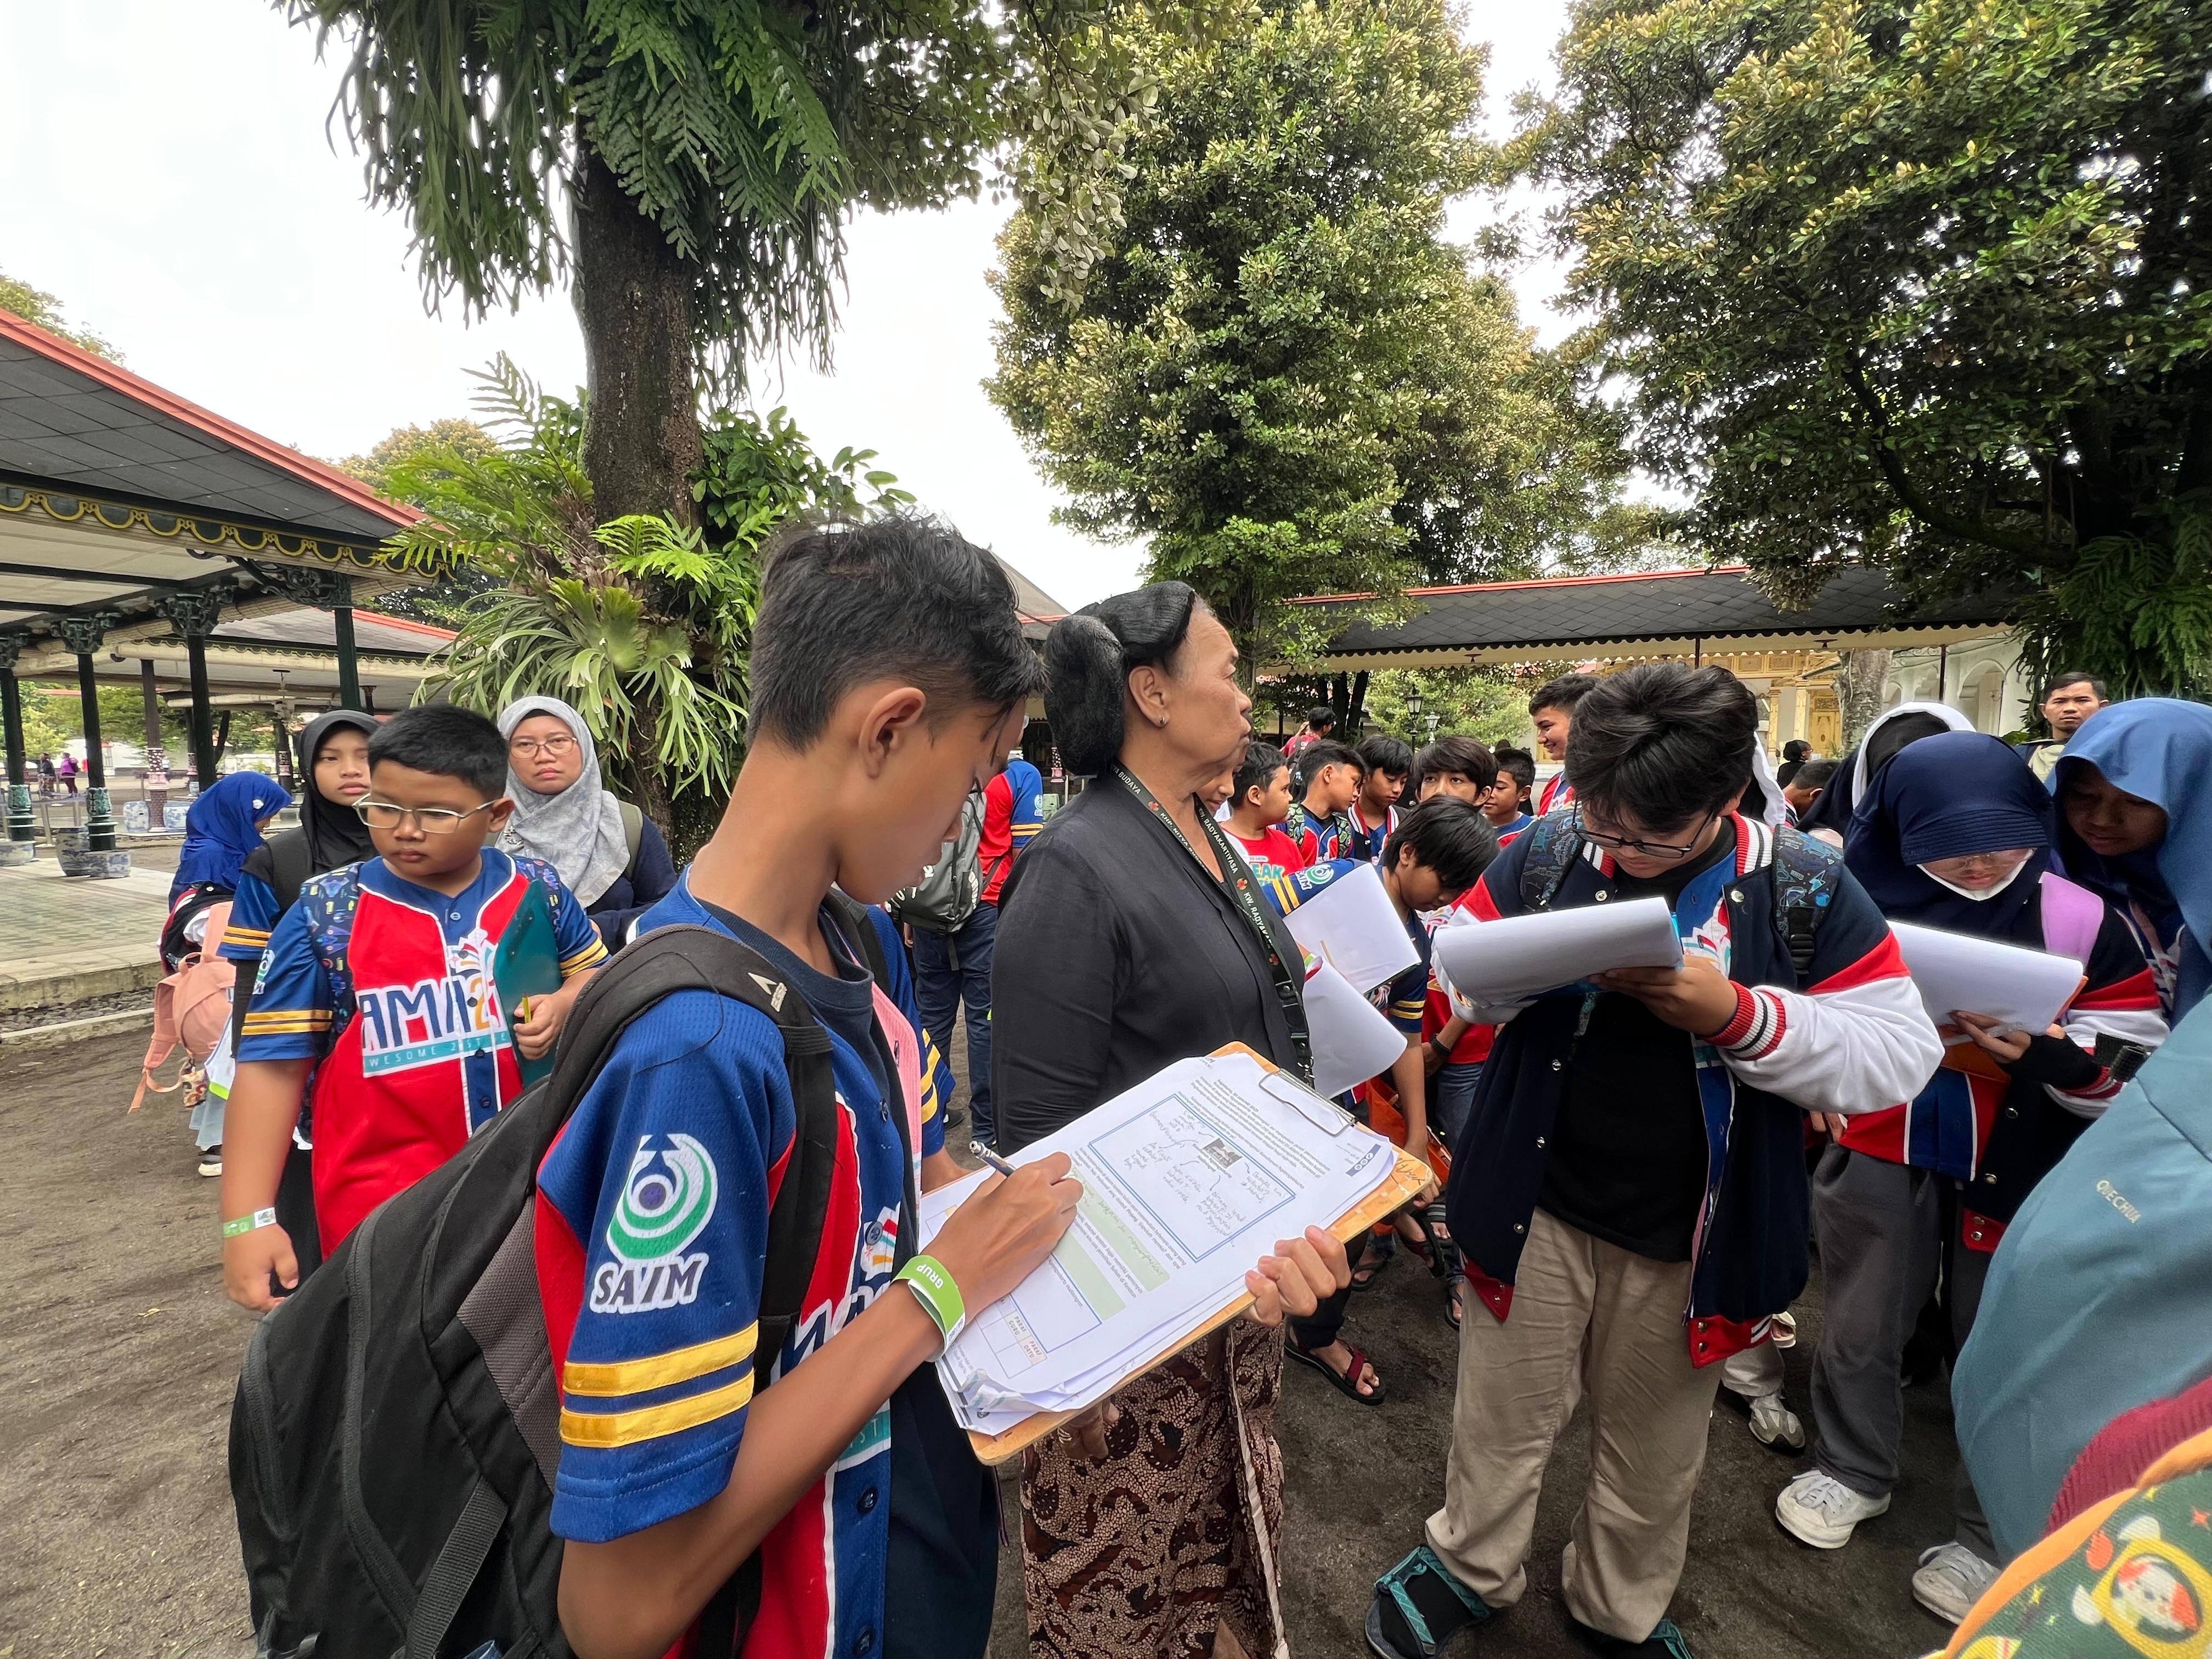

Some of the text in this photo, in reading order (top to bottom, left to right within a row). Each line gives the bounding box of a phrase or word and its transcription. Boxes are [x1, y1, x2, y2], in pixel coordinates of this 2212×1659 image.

[1118, 771, 1141, 794] BUDAYA
[1160, 812, 1172, 827] KHP.
[1173, 828, 1188, 847] NITYA
[1204, 819, 1238, 873] RADYAKARTIYASA
[1244, 892, 1254, 906] KW.
[2096, 1180, 2142, 1224] QUECHUA
[594, 1259, 703, 1306] SAIM
[916, 1263, 944, 1289] GRUP
[1007, 1314, 1027, 1336] PARAF GURU
